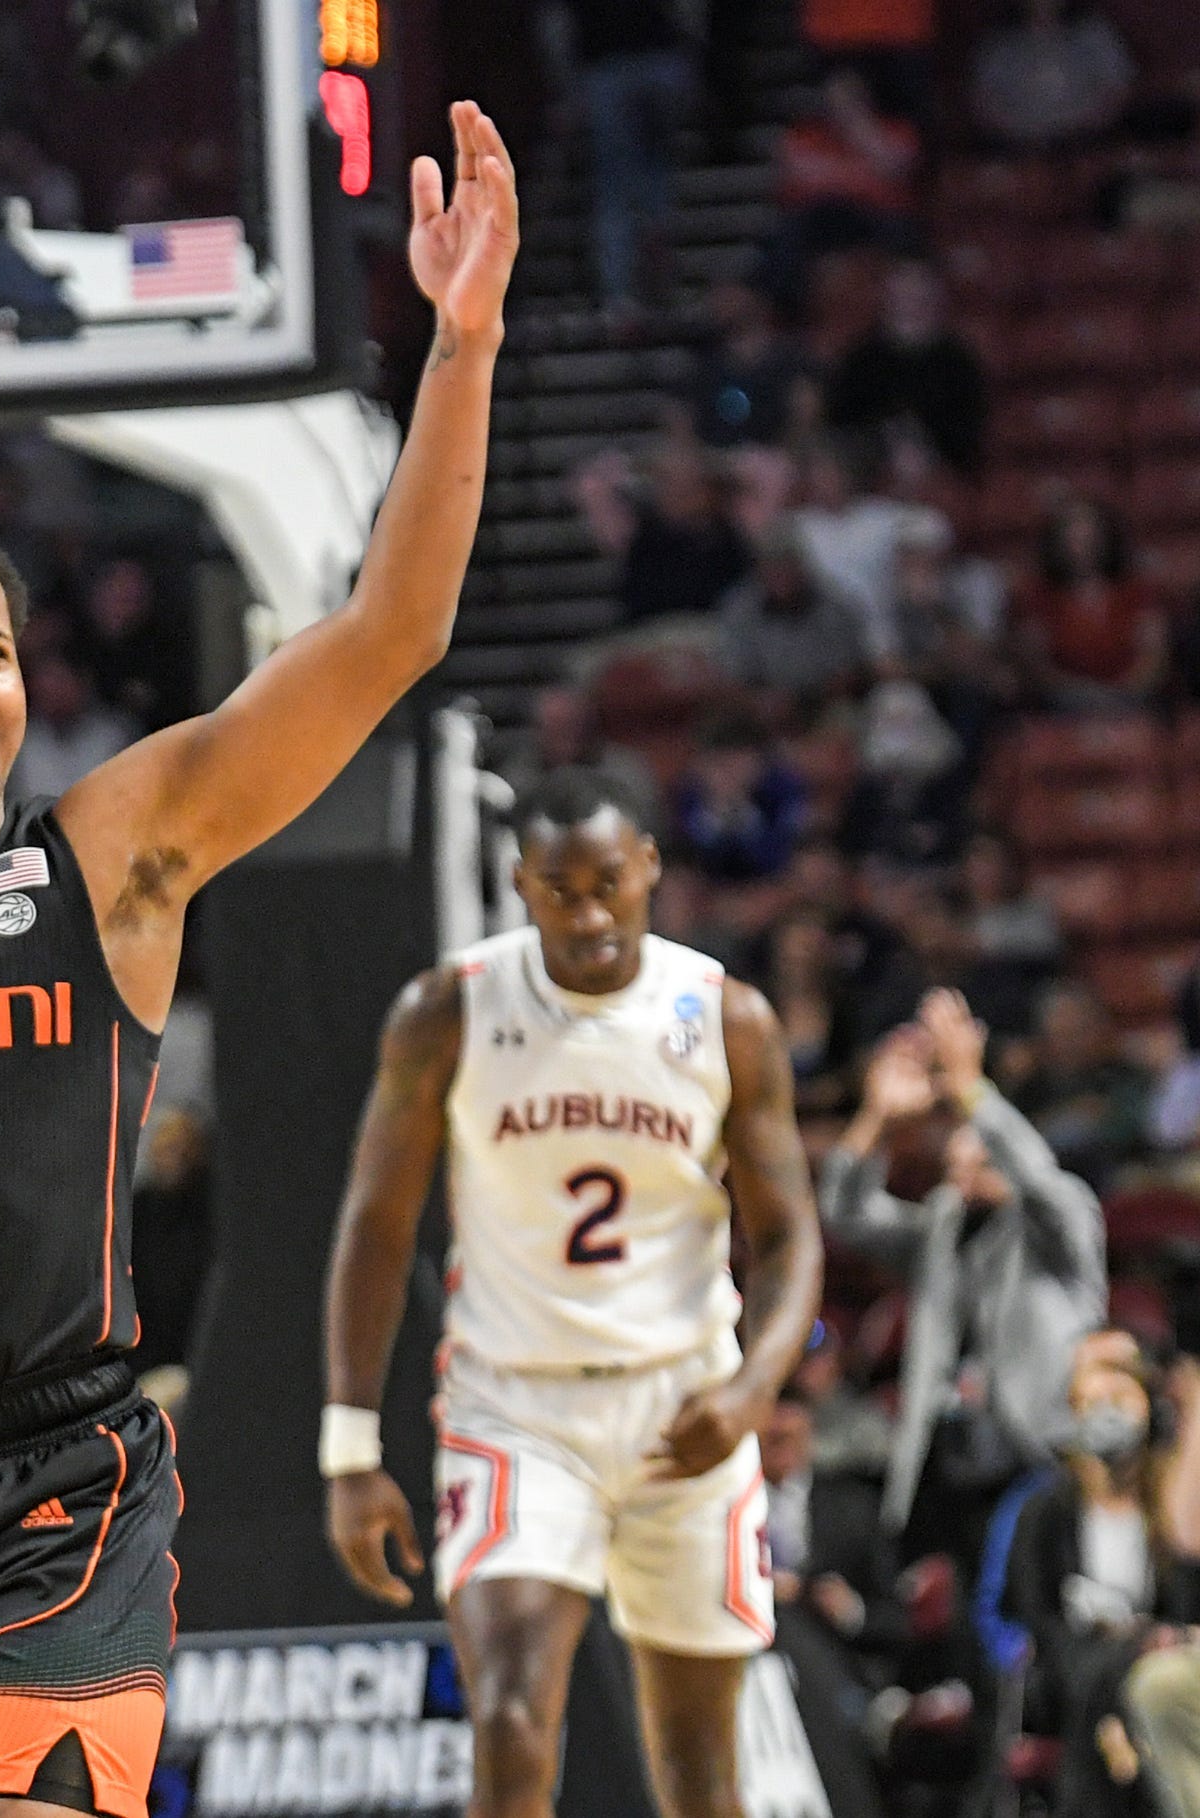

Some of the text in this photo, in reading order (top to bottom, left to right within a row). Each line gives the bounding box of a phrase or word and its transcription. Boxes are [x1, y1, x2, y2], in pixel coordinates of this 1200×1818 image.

[494, 1093, 693, 1147] AUBURN
[565, 1162, 628, 1266] 2
[21, 1516, 74, 1529] adidas
[174, 1640, 428, 1733] MARCH
[204, 1720, 475, 1811] MADNE
